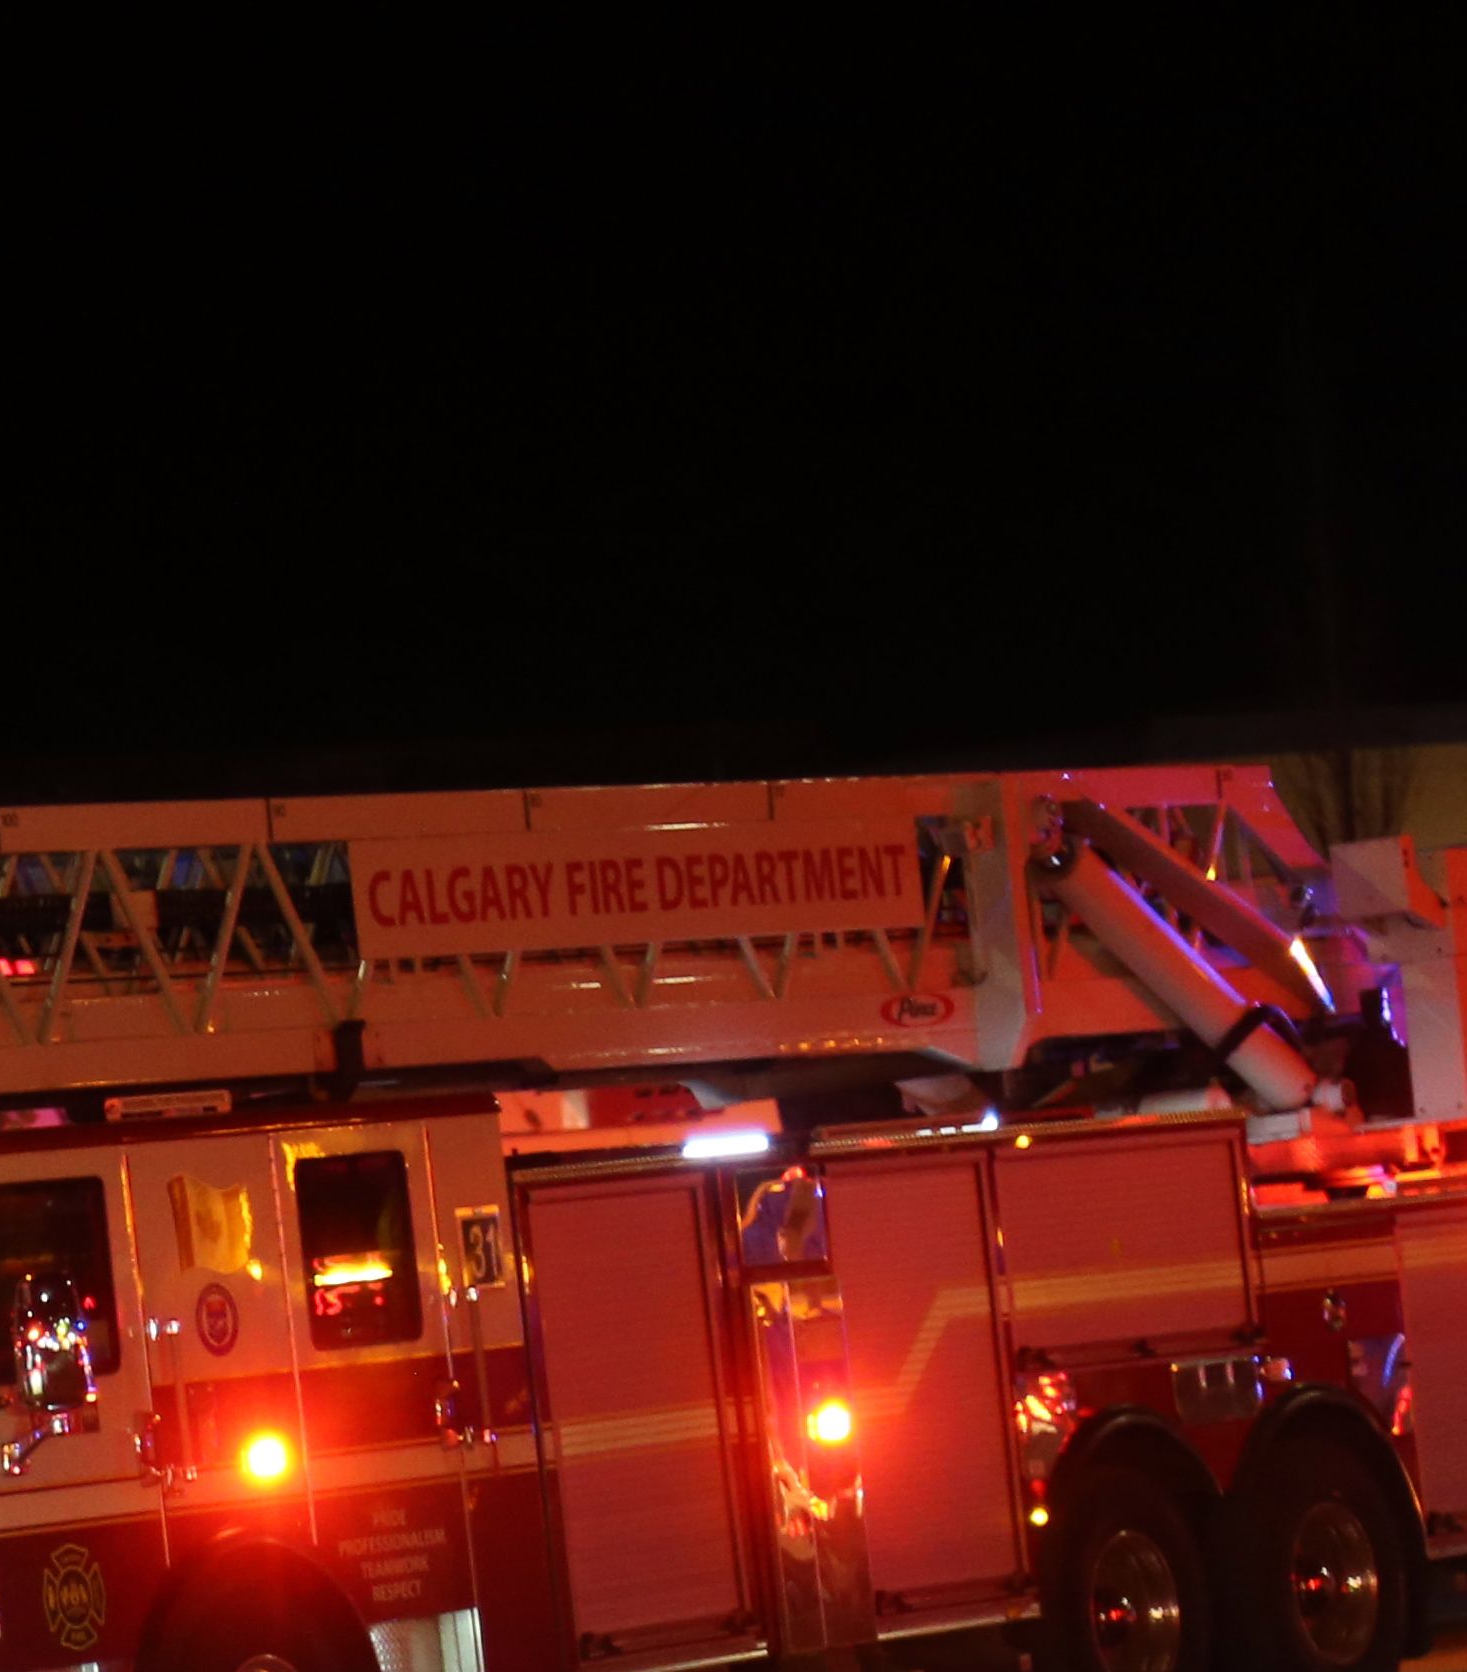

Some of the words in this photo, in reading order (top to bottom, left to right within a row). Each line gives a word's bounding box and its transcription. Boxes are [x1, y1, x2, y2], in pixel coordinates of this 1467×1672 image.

[368, 860, 553, 927] CALGARY
[566, 856, 649, 916] FIRE
[658, 844, 906, 911] DEPARTMENT
[469, 1223, 498, 1279] 31
